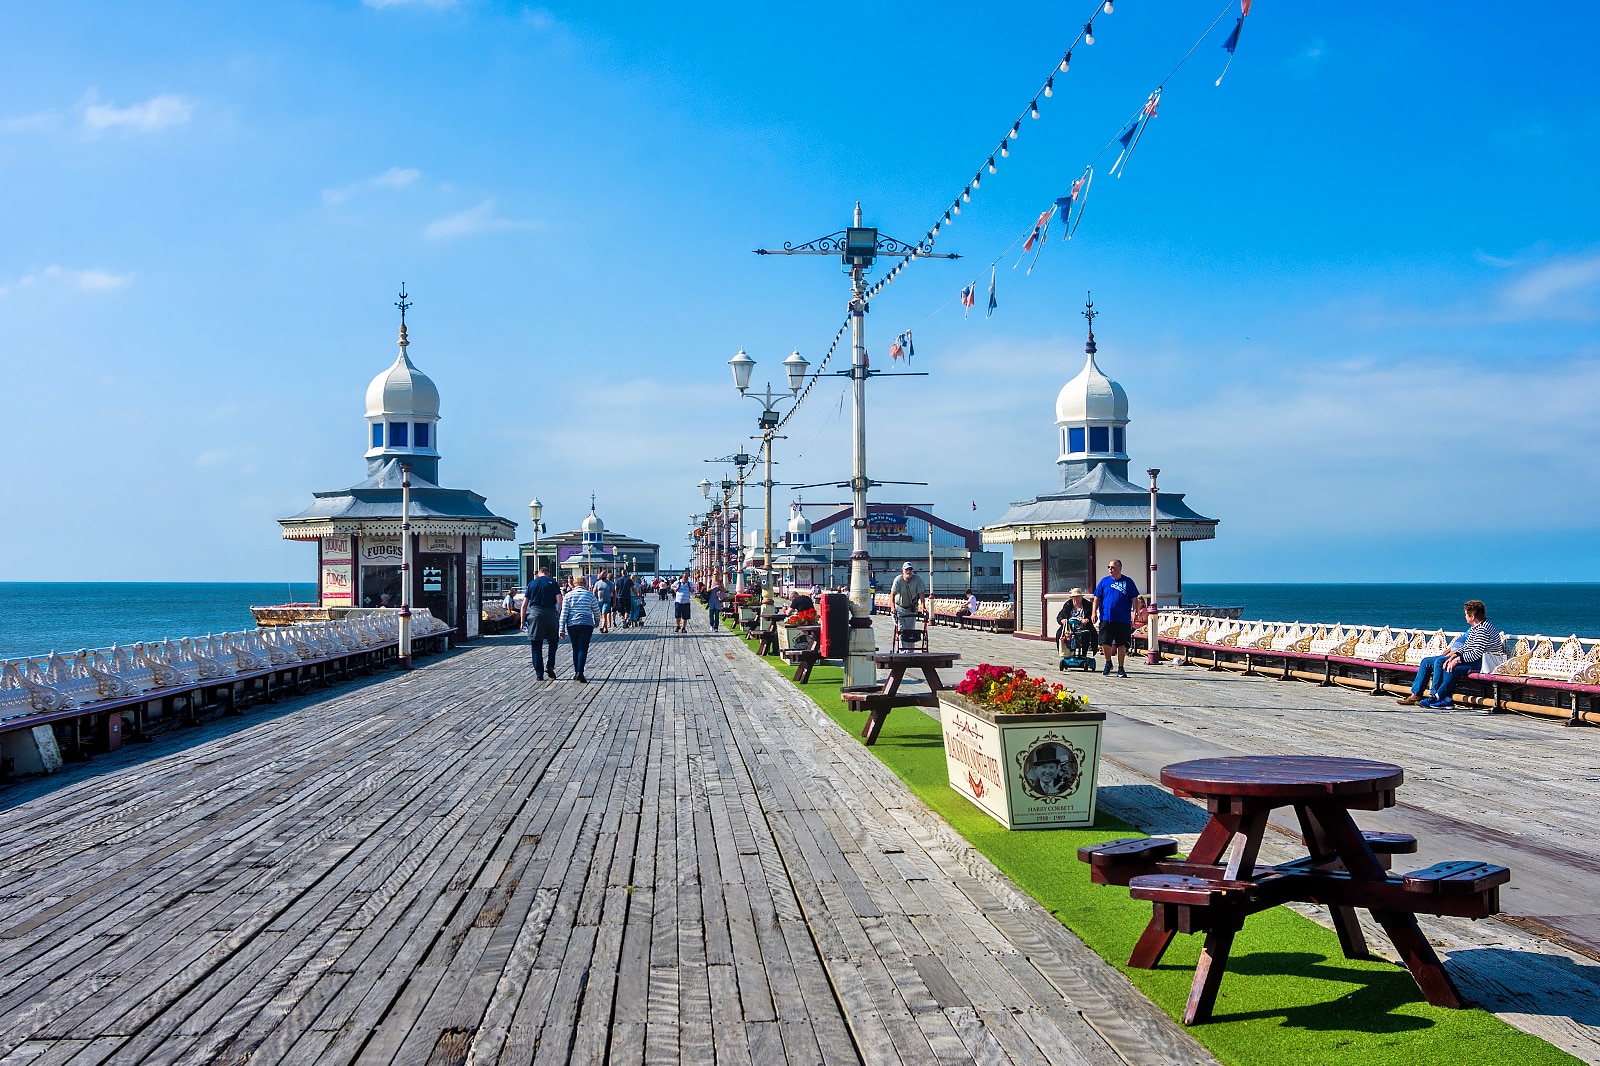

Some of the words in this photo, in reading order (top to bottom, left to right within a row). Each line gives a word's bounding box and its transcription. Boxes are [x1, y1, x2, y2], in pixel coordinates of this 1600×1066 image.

[867, 524, 907, 533] EATRE
[367, 545, 403, 557] FUDGES
[325, 572, 347, 587] FUDGES
